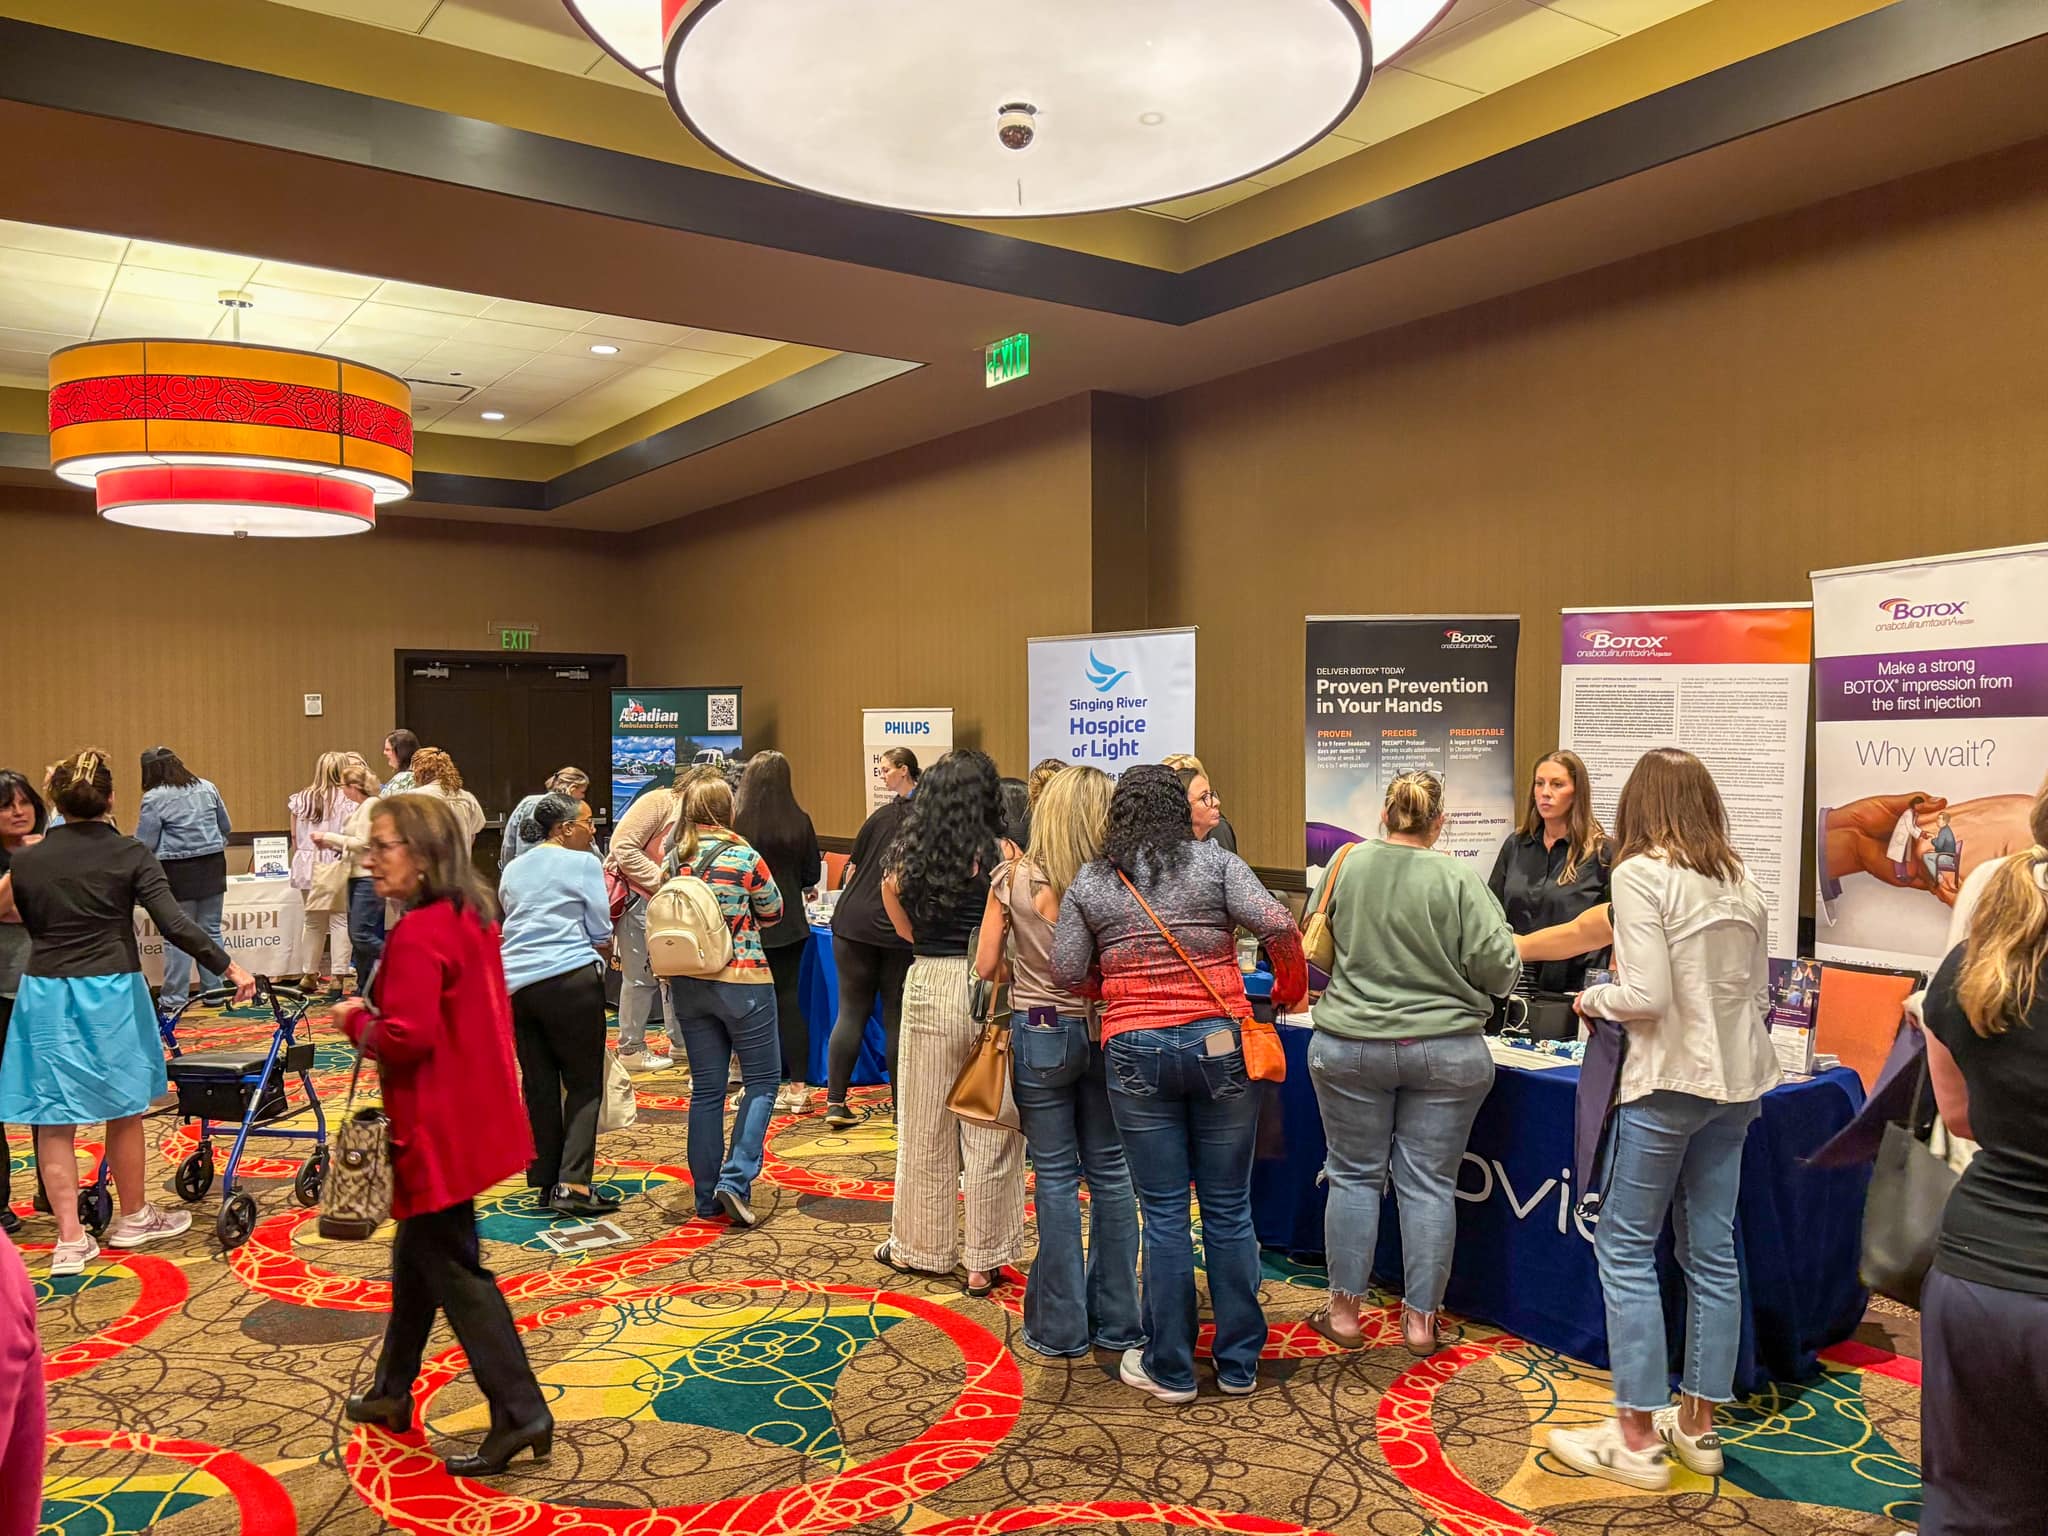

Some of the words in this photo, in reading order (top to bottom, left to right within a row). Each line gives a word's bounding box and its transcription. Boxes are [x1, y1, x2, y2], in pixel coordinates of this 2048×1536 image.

[502, 630, 531, 649] EXIT
[1316, 667, 1349, 675] DELIVER
[1381, 667, 1406, 675] TODAY
[1878, 662, 1915, 676] Make
[1918, 663, 1927, 673] a
[1930, 659, 1975, 674] strong
[1317, 679, 1384, 695] Proven
[1388, 677, 1488, 694] Prevention
[1902, 676, 1976, 694] impression
[1980, 675, 2012, 689] from
[1069, 698, 1114, 712] Singing
[1117, 696, 1148, 708] River
[1317, 697, 1334, 714] in
[1337, 697, 1382, 714] Your
[1385, 697, 1443, 713] Hands
[1872, 698, 1894, 711] the
[1897, 697, 1921, 710] first
[1924, 695, 1981, 712] injection
[619, 707, 679, 722] Acadian
[885, 721, 930, 735] PHILIPS
[1070, 715, 1146, 738] Hospice
[1317, 730, 1352, 738] PROVEN
[1382, 729, 1417, 737] PRECISE
[1450, 728, 1505, 736] PREDICTABLE
[1072, 744, 1088, 758] of
[1091, 738, 1139, 760] Light
[1856, 740, 1916, 773] Why
[1924, 738, 1996, 767] wait?
[223, 935, 281, 949] Alliance
